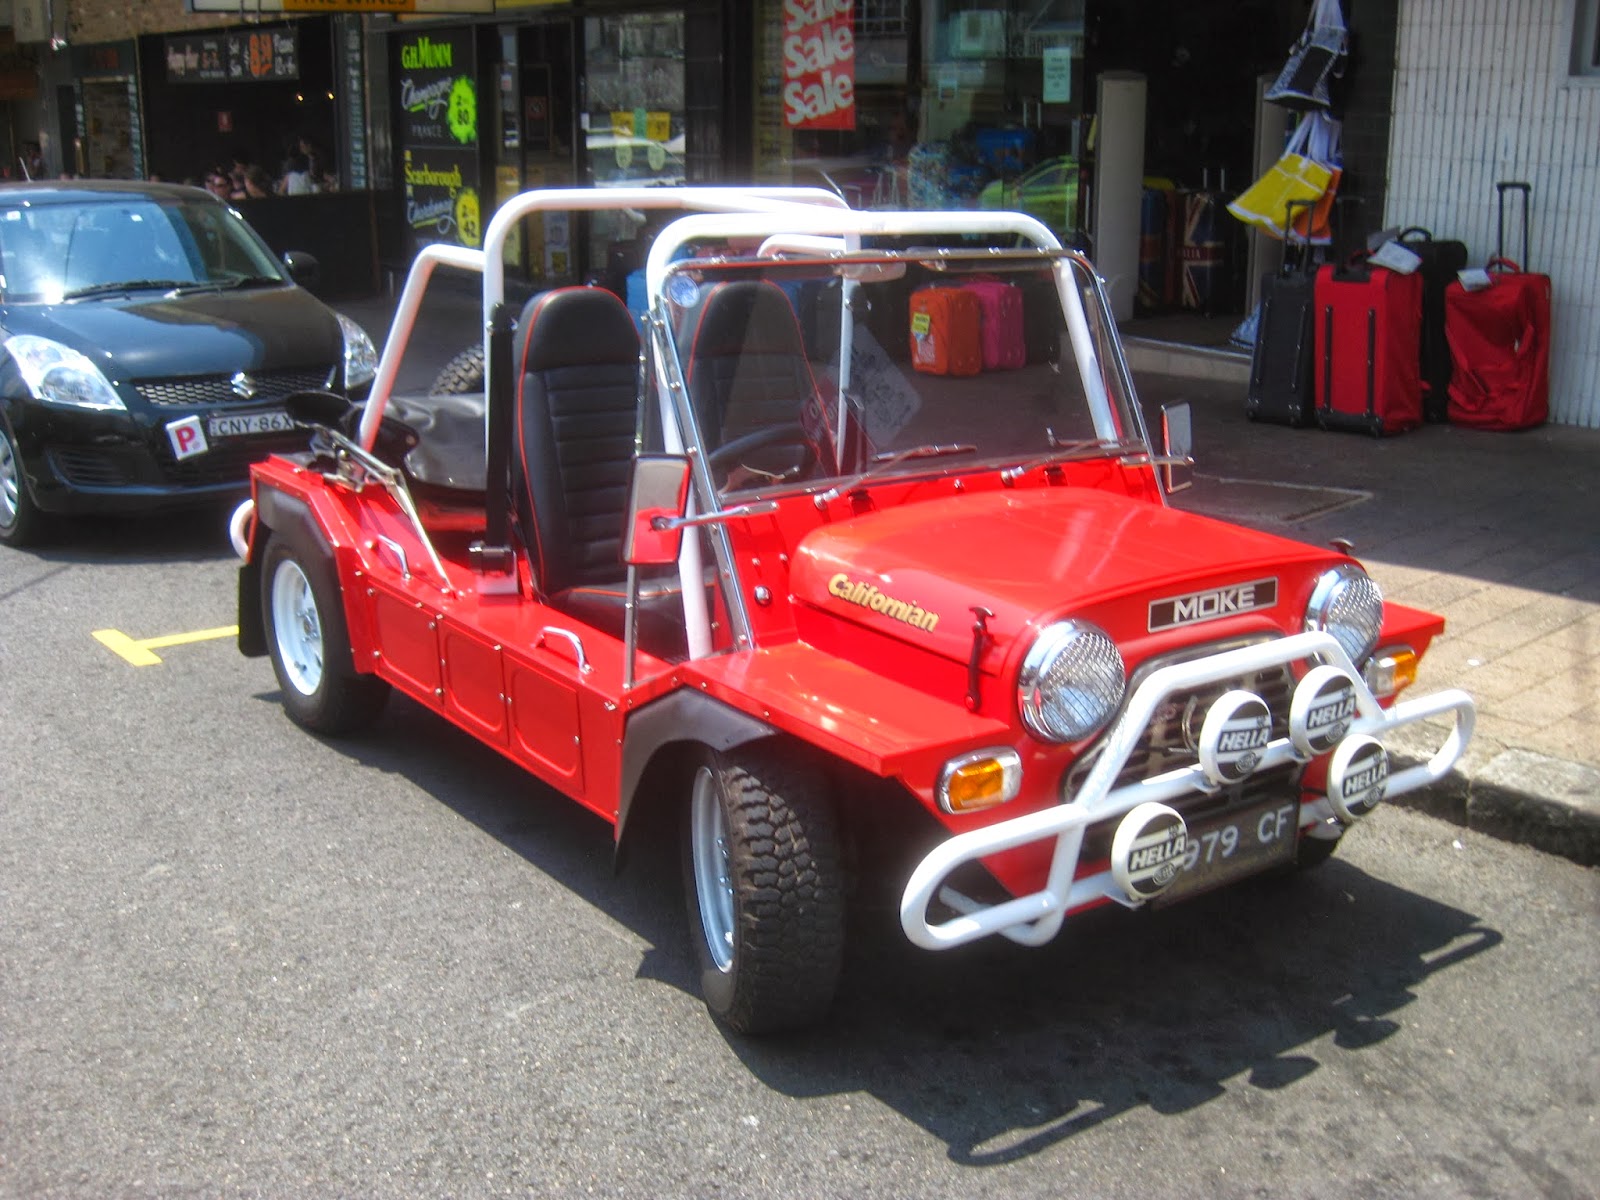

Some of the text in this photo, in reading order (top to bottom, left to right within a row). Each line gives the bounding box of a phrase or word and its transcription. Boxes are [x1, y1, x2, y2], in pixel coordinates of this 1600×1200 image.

[784, 23, 854, 79] Sale
[784, 70, 854, 125] Sale
[174, 425, 196, 453] P
[828, 573, 940, 633] Californian
[1173, 585, 1256, 624] MOKE
[1308, 696, 1355, 728] HELLA
[1219, 728, 1269, 752] HELLA
[1344, 761, 1387, 796] HELLA
[1257, 803, 1294, 844] CF
[1129, 834, 1186, 871] HELLA
